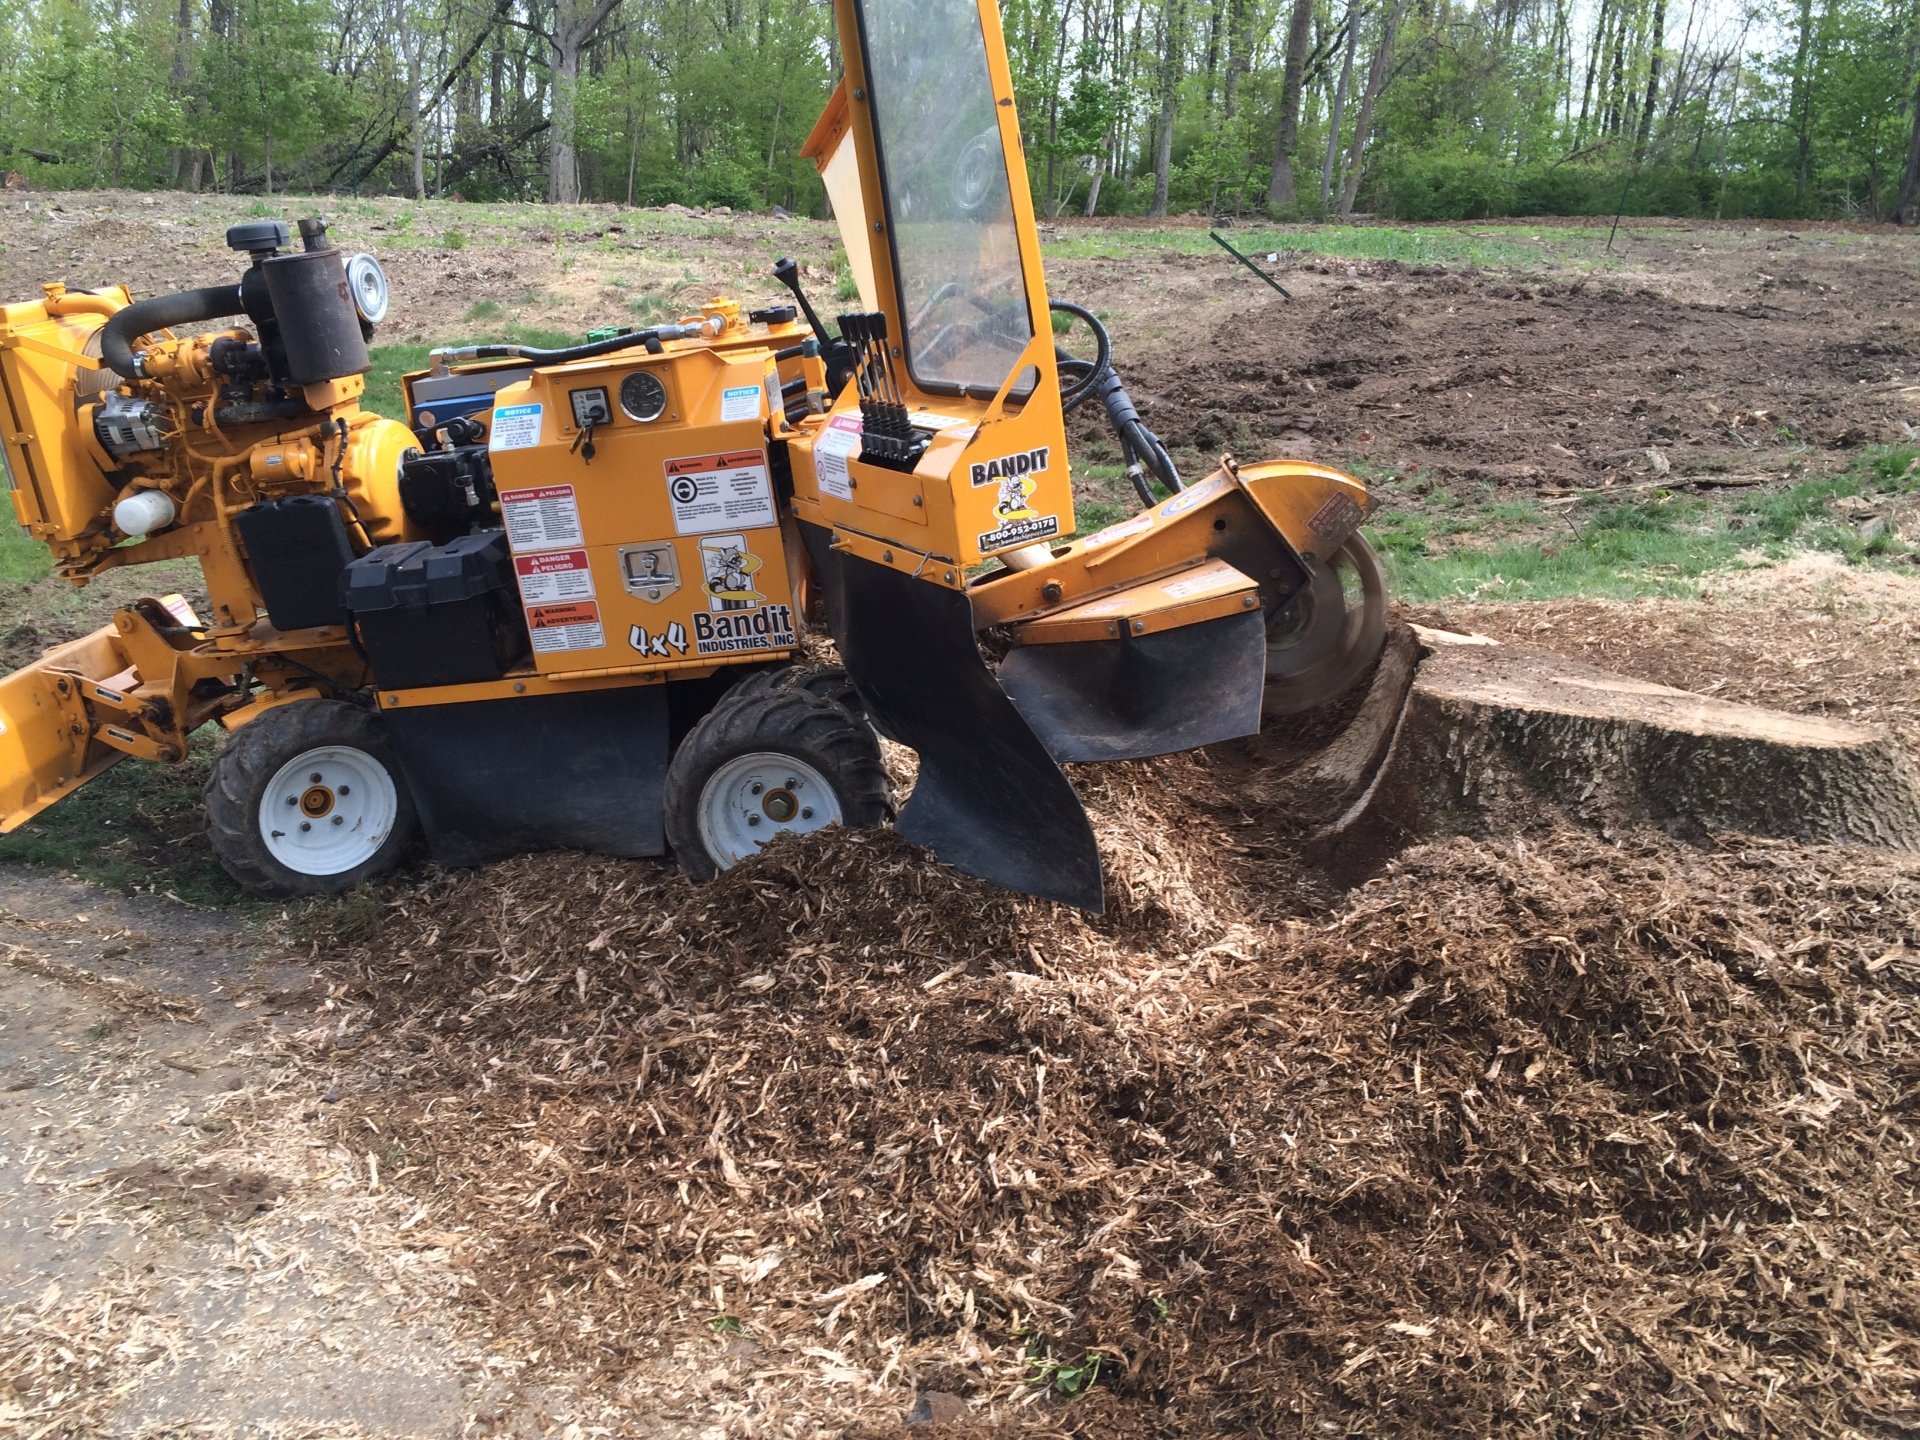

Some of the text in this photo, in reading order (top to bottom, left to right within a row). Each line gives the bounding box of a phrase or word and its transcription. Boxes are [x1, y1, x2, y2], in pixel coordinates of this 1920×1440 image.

[727, 389, 756, 397] NOTICE
[504, 408, 531, 416] NOTICE
[971, 448, 1049, 486] BANDIT
[510, 492, 535, 500] DANGER
[545, 488, 571, 496] PELIGRO
[539, 554, 571, 563] DANGER
[541, 562, 574, 571] PELIGRO
[544, 606, 577, 614] WARNING
[546, 614, 594, 624] ADVERTENCIA
[693, 605, 793, 640] Bandit
[628, 621, 690, 659] 4x4
[698, 634, 798, 653] INDUSTRIES, INC.
